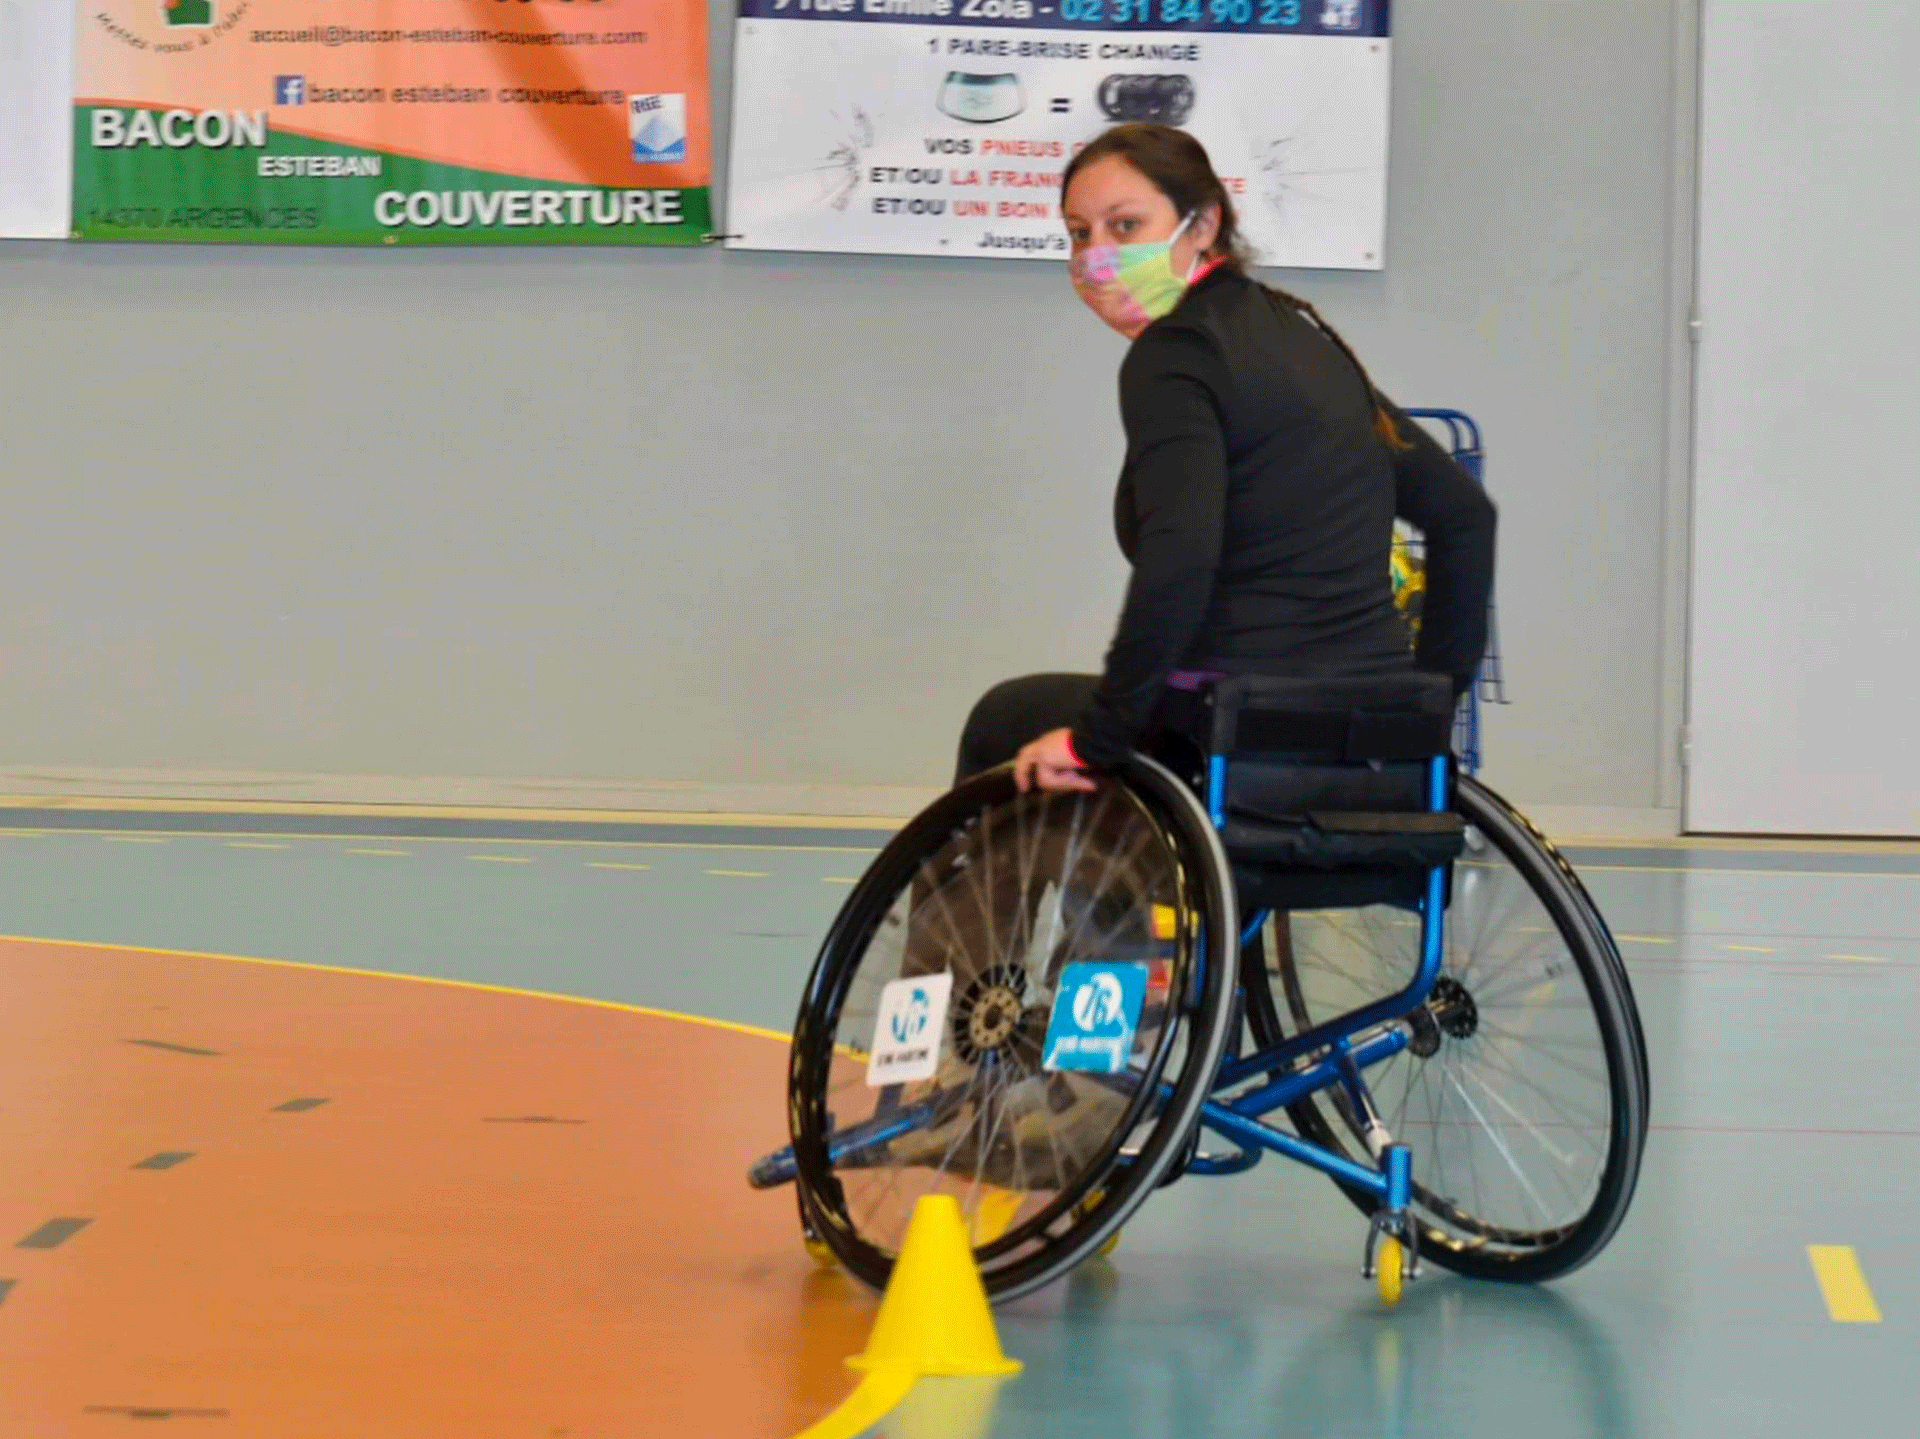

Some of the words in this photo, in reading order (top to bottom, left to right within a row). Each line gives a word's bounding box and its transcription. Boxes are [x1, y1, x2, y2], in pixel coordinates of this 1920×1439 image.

[960, 0, 1034, 19] Zola
[1060, 0, 1103, 21] 02
[1110, 0, 1151, 22] 31
[1161, 0, 1203, 23] 84
[1210, 0, 1253, 24] 90
[1259, 0, 1302, 25] 23
[947, 38, 1090, 59] PARE-BRISE
[309, 83, 386, 103] bacon
[392, 84, 490, 103] esteban
[497, 88, 625, 106] couverture
[91, 108, 268, 148] BACON
[925, 138, 973, 155] VOS
[980, 140, 1064, 158] PNEUS
[257, 155, 382, 177] ESTEBAN
[949, 169, 982, 187] LA
[165, 207, 320, 229] ARGENCES
[374, 189, 684, 227] COUVERTURE
[952, 199, 991, 218] UN
[996, 201, 1050, 219] BON
